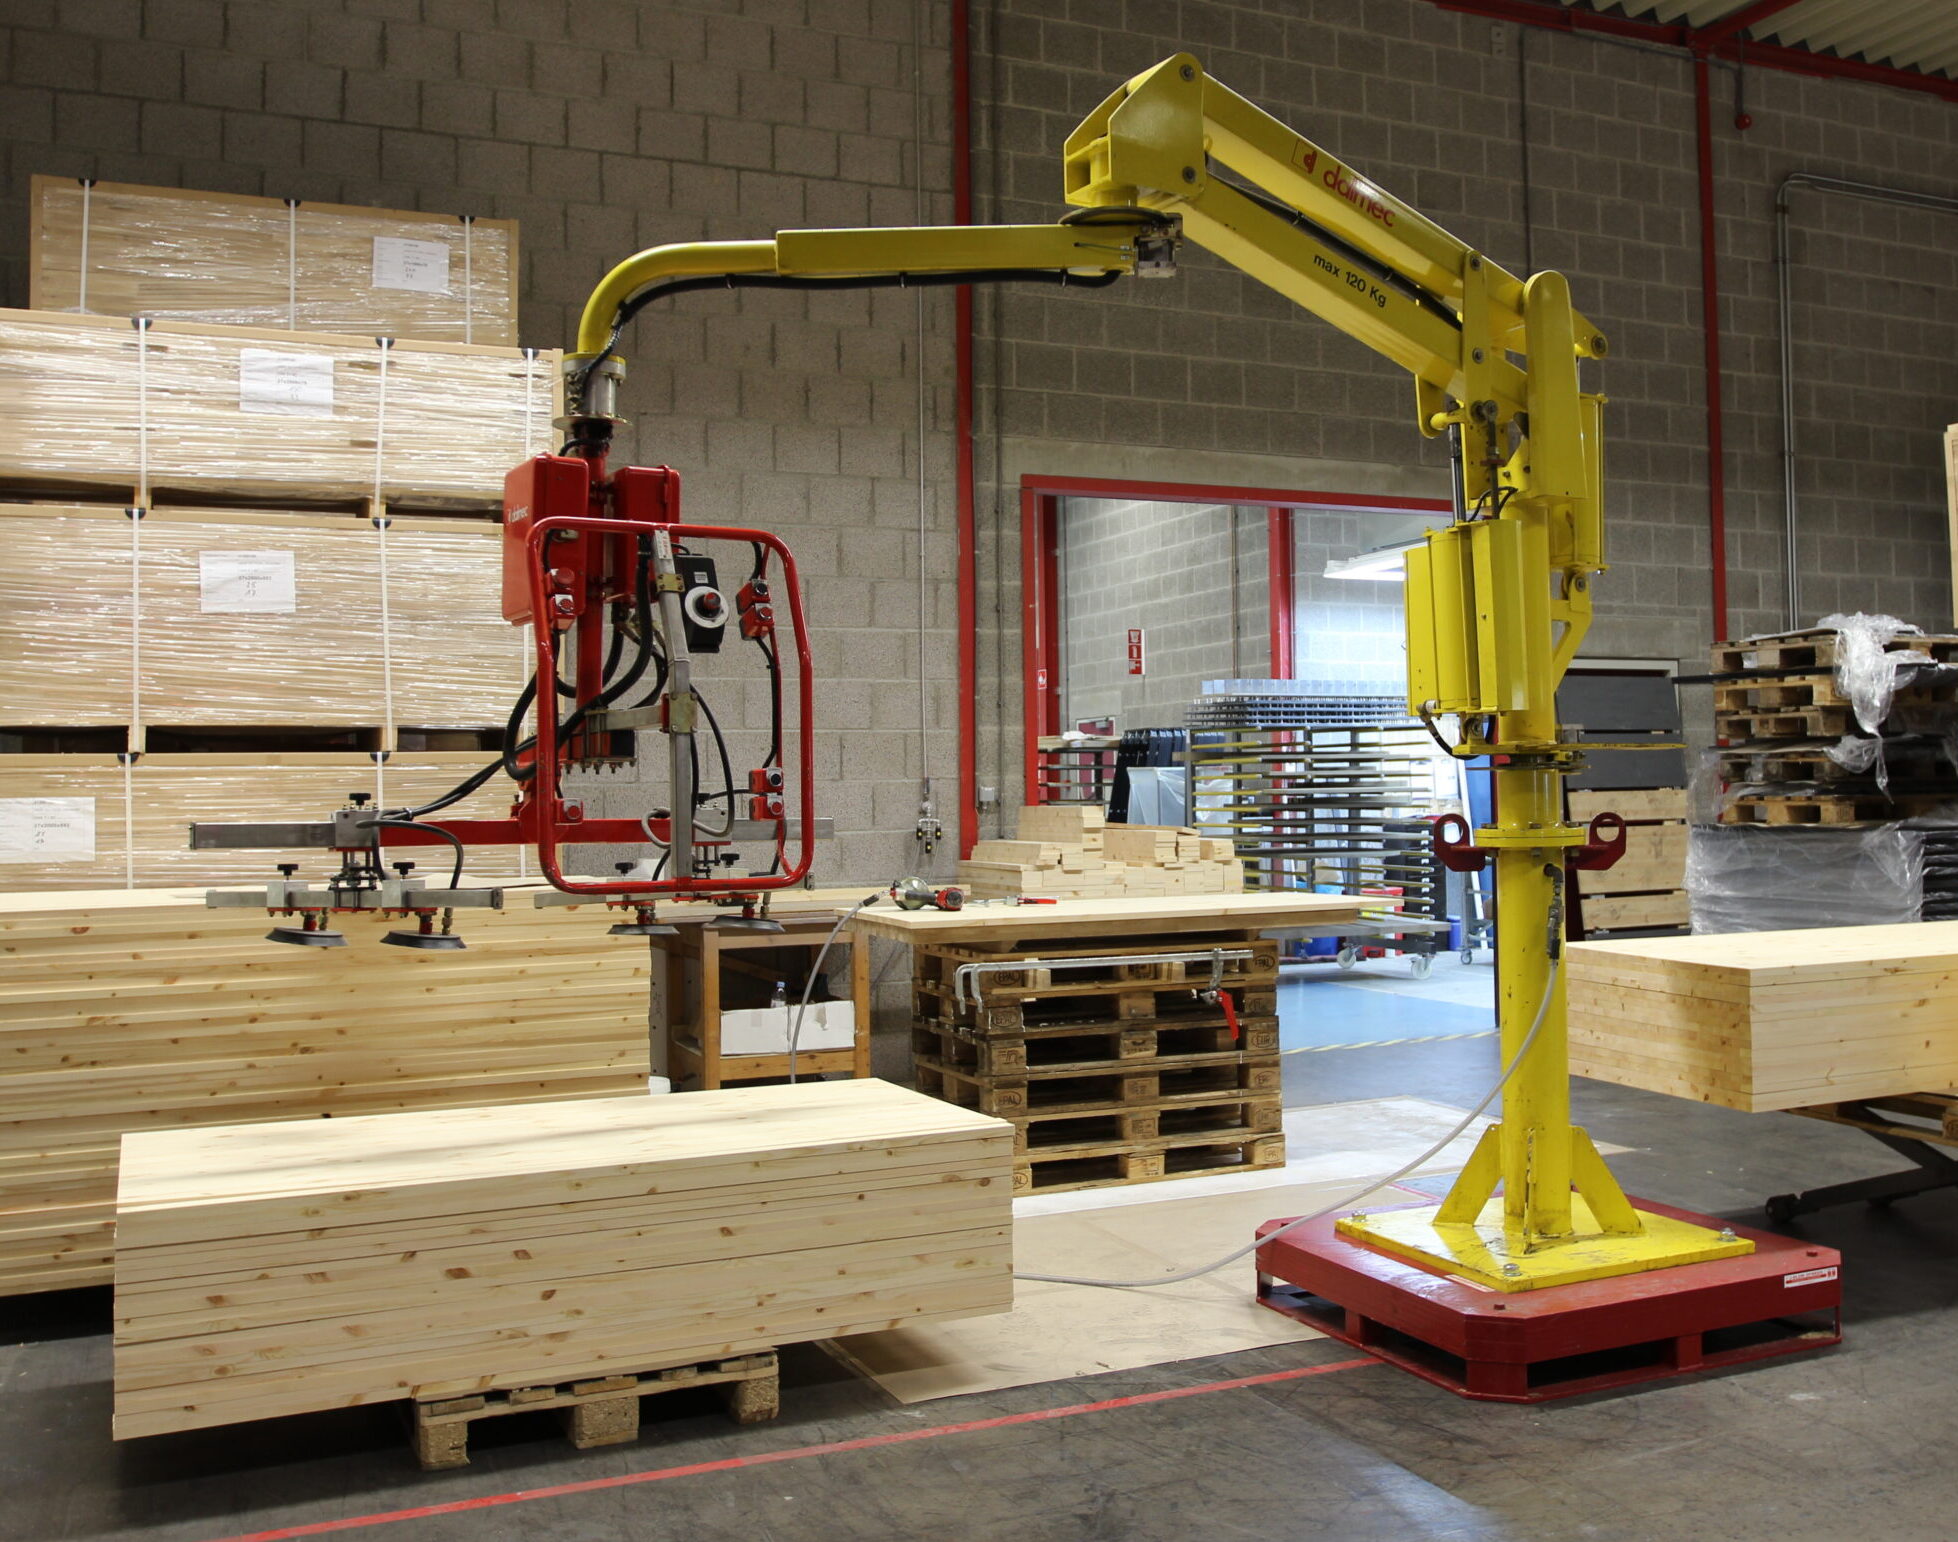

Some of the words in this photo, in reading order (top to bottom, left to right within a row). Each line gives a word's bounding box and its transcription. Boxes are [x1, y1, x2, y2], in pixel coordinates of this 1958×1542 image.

[1323, 165, 1396, 227] dalmec
[1313, 254, 1340, 277] max
[1345, 271, 1366, 292] 120
[1369, 286, 1387, 308] Kg
